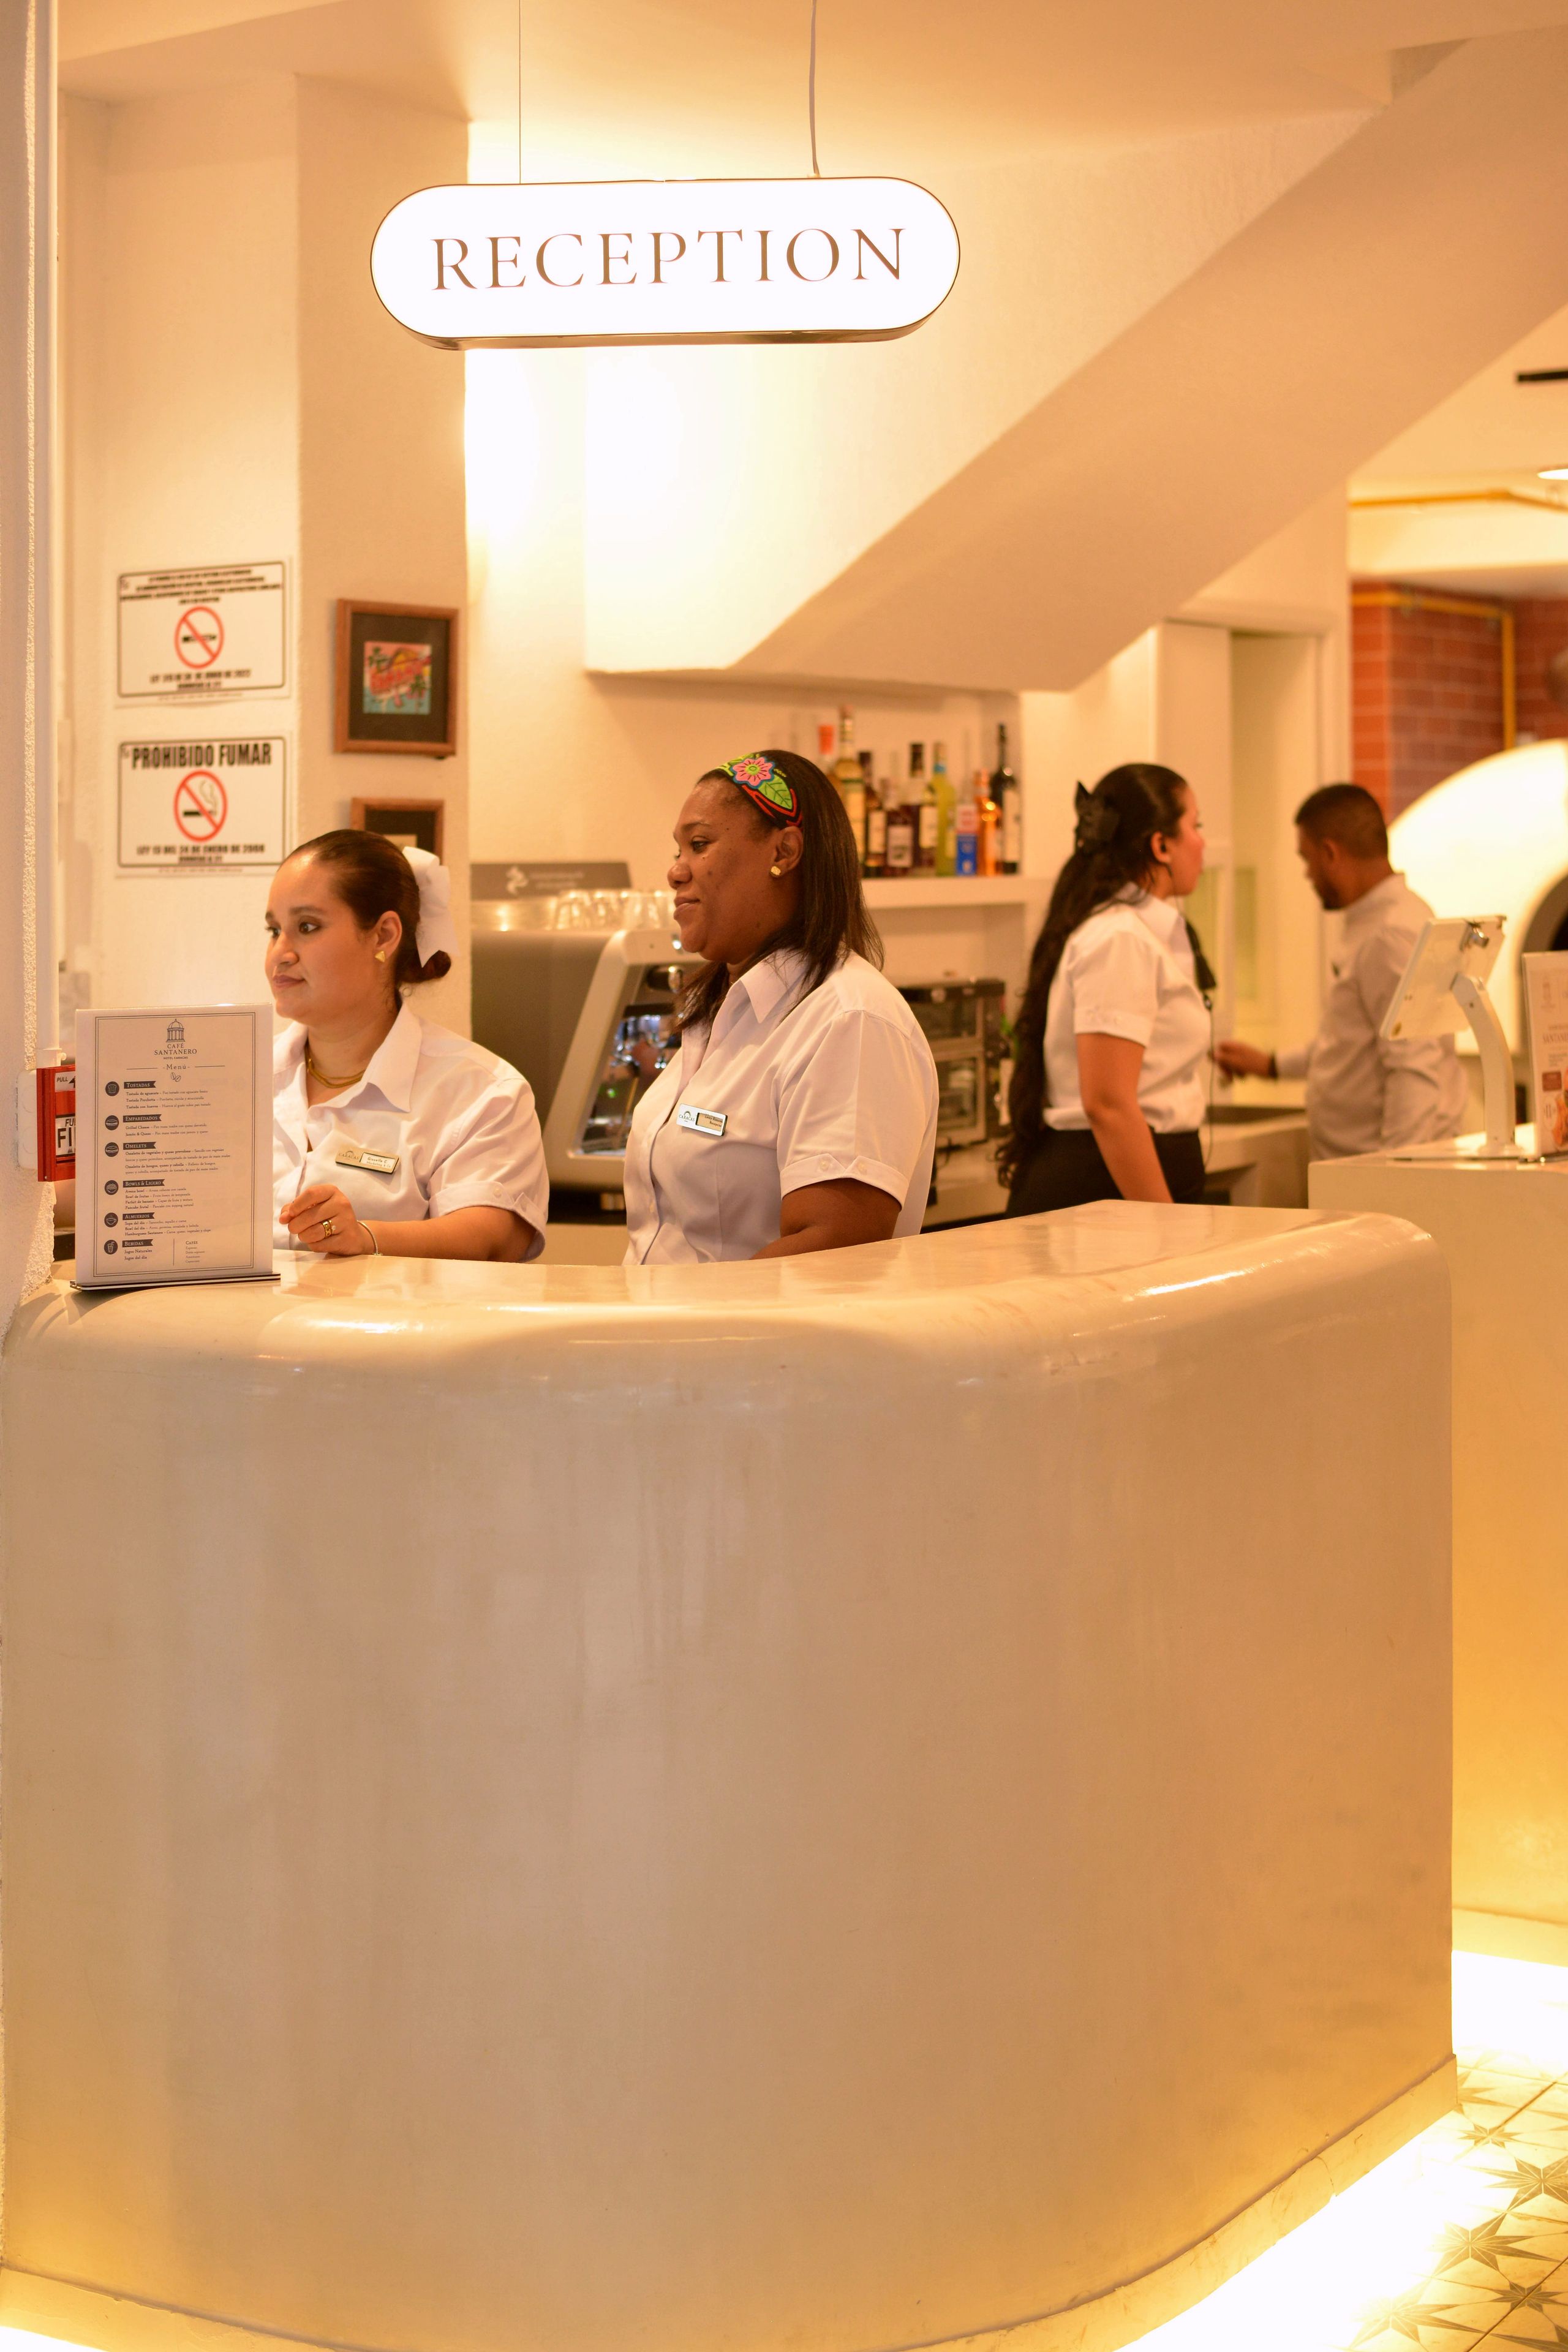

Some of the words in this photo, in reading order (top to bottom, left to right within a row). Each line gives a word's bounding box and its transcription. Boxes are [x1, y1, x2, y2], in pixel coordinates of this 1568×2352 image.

[431, 228, 907, 291] RECEPTION
[132, 745, 214, 769] PROHIBIDO
[219, 743, 271, 767] FUMAR
[58, 1127, 75, 1148] FI
